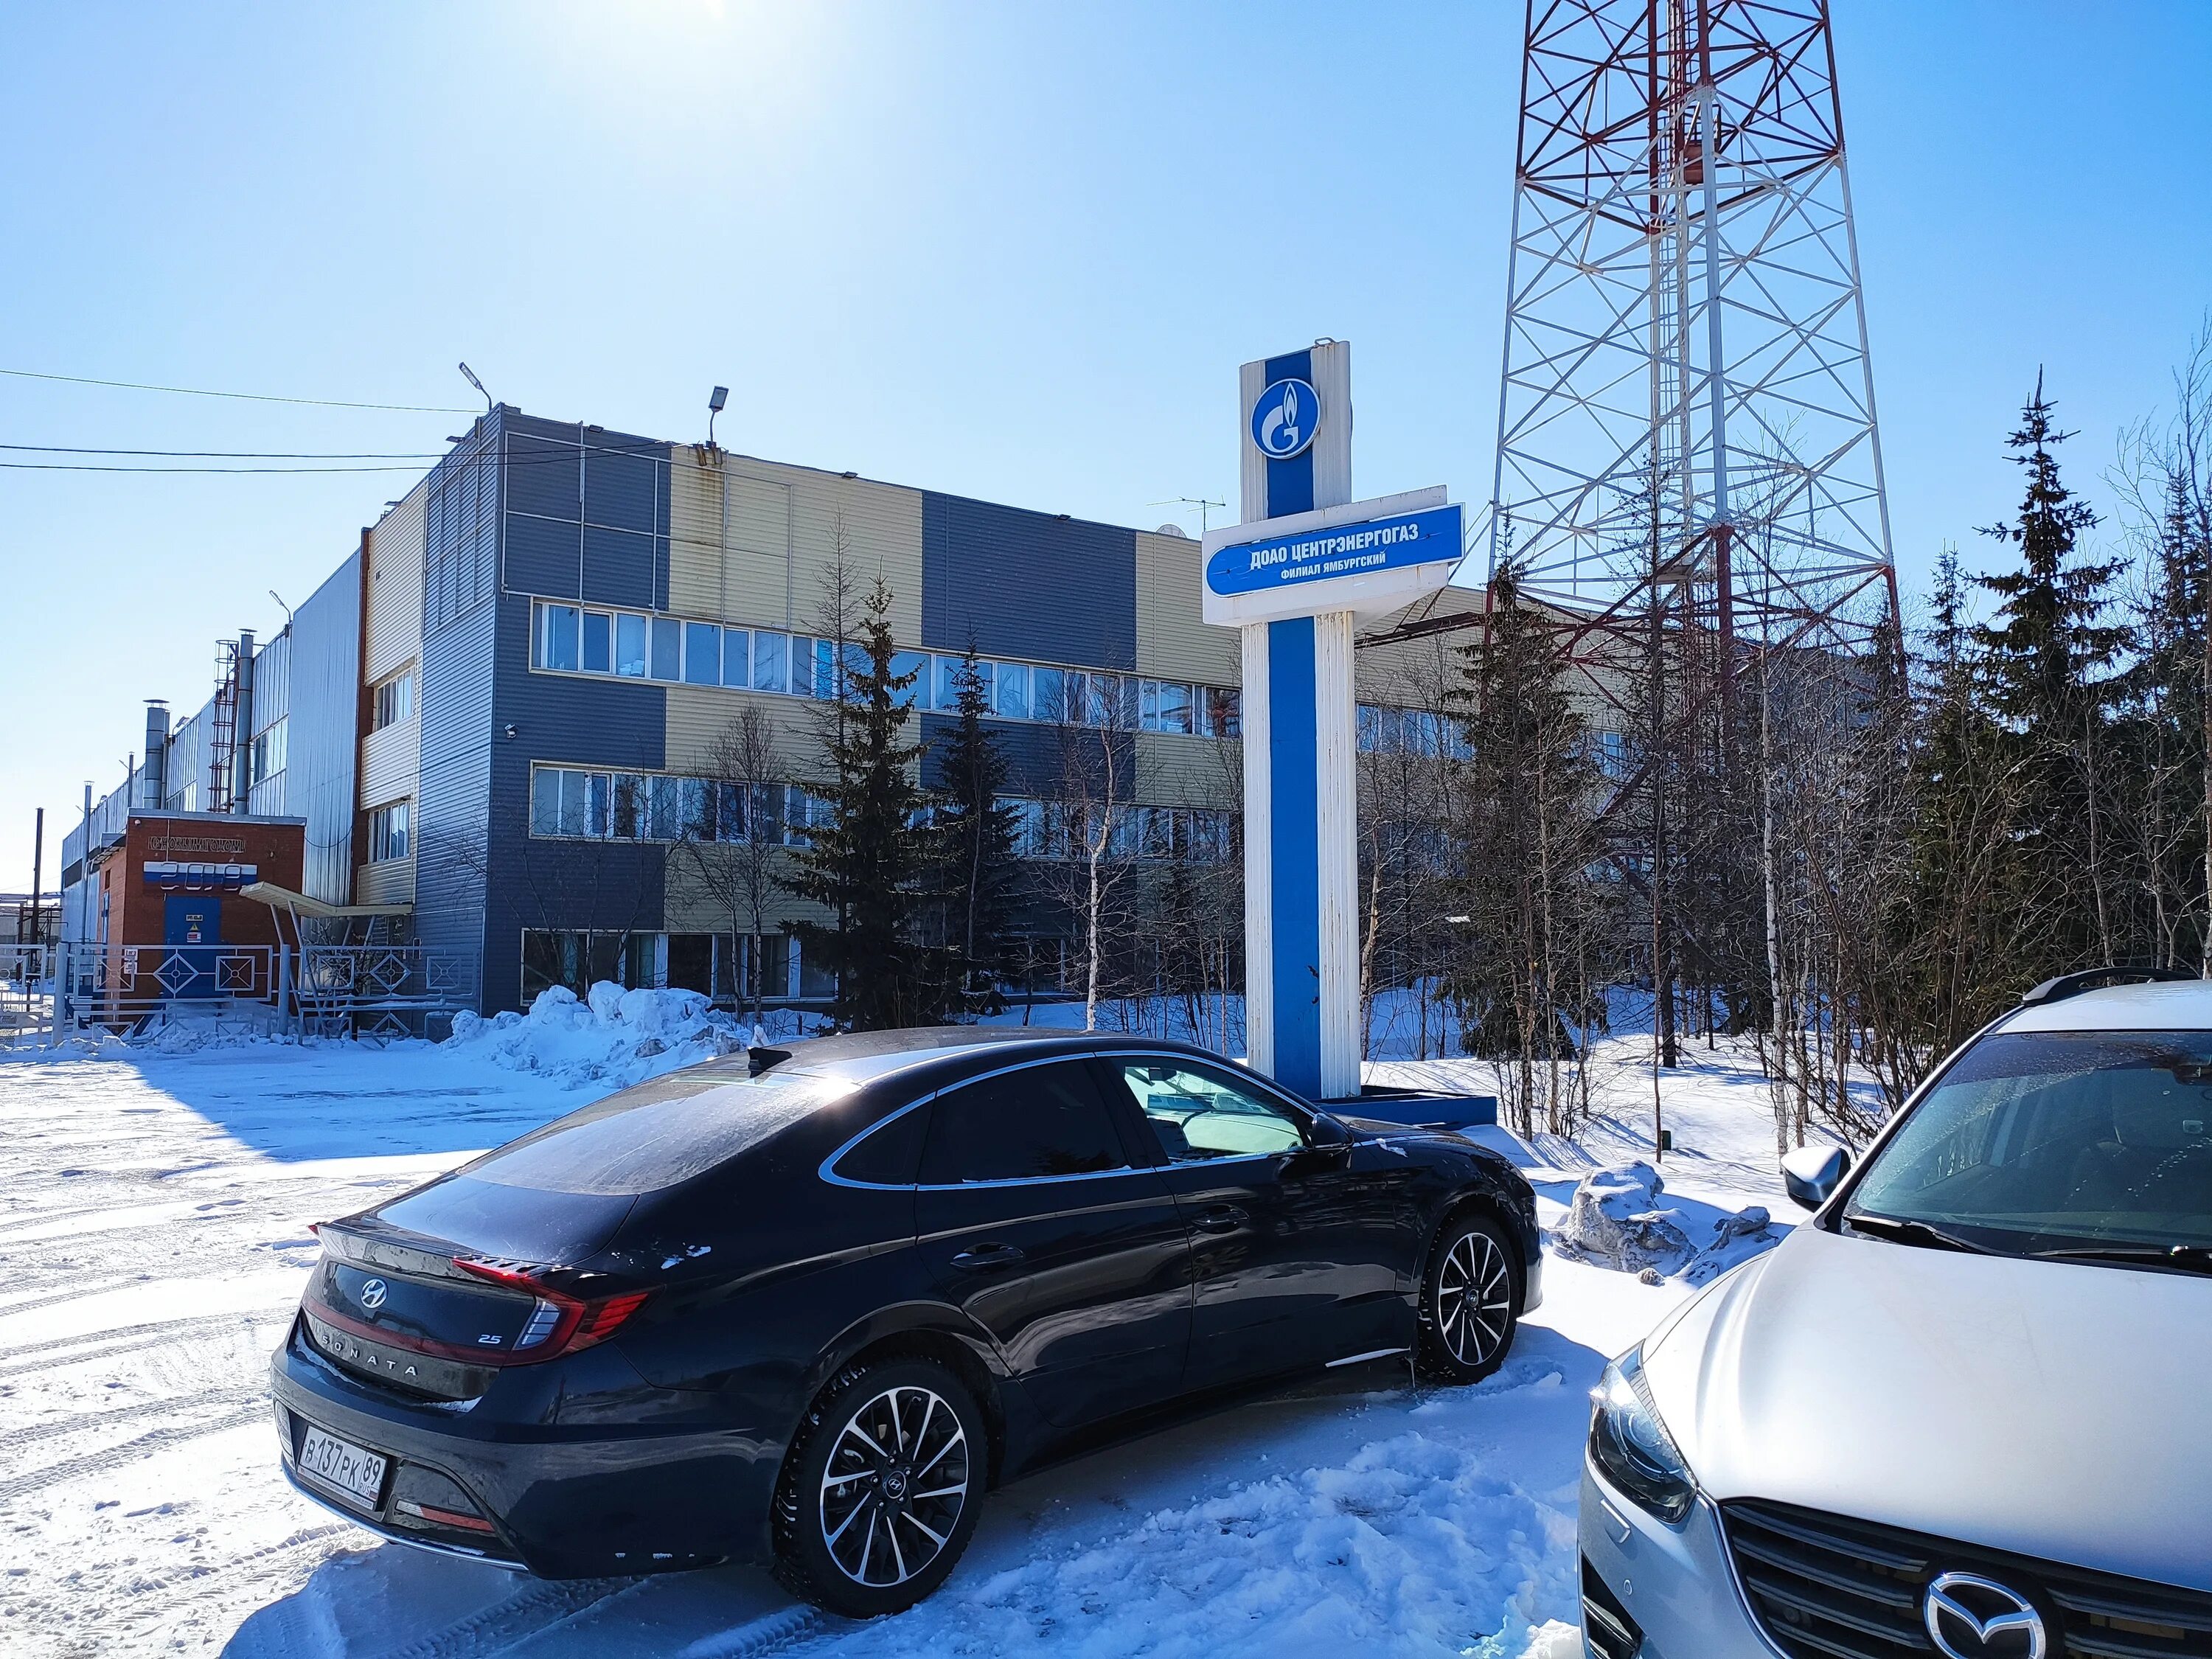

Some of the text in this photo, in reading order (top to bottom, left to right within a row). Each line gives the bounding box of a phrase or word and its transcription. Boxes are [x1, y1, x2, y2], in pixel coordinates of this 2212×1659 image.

[1251, 524, 1419, 570] ДОАО ЦЕНТРЭНЕРГОГАЗ
[1281, 552, 1386, 580] ФИЛИАЛ ЯМБУРГСКИЙ
[321, 1335, 418, 1376] SONATA
[363, 1456, 381, 1486] 89
[359, 1483, 370, 1495] RUS
